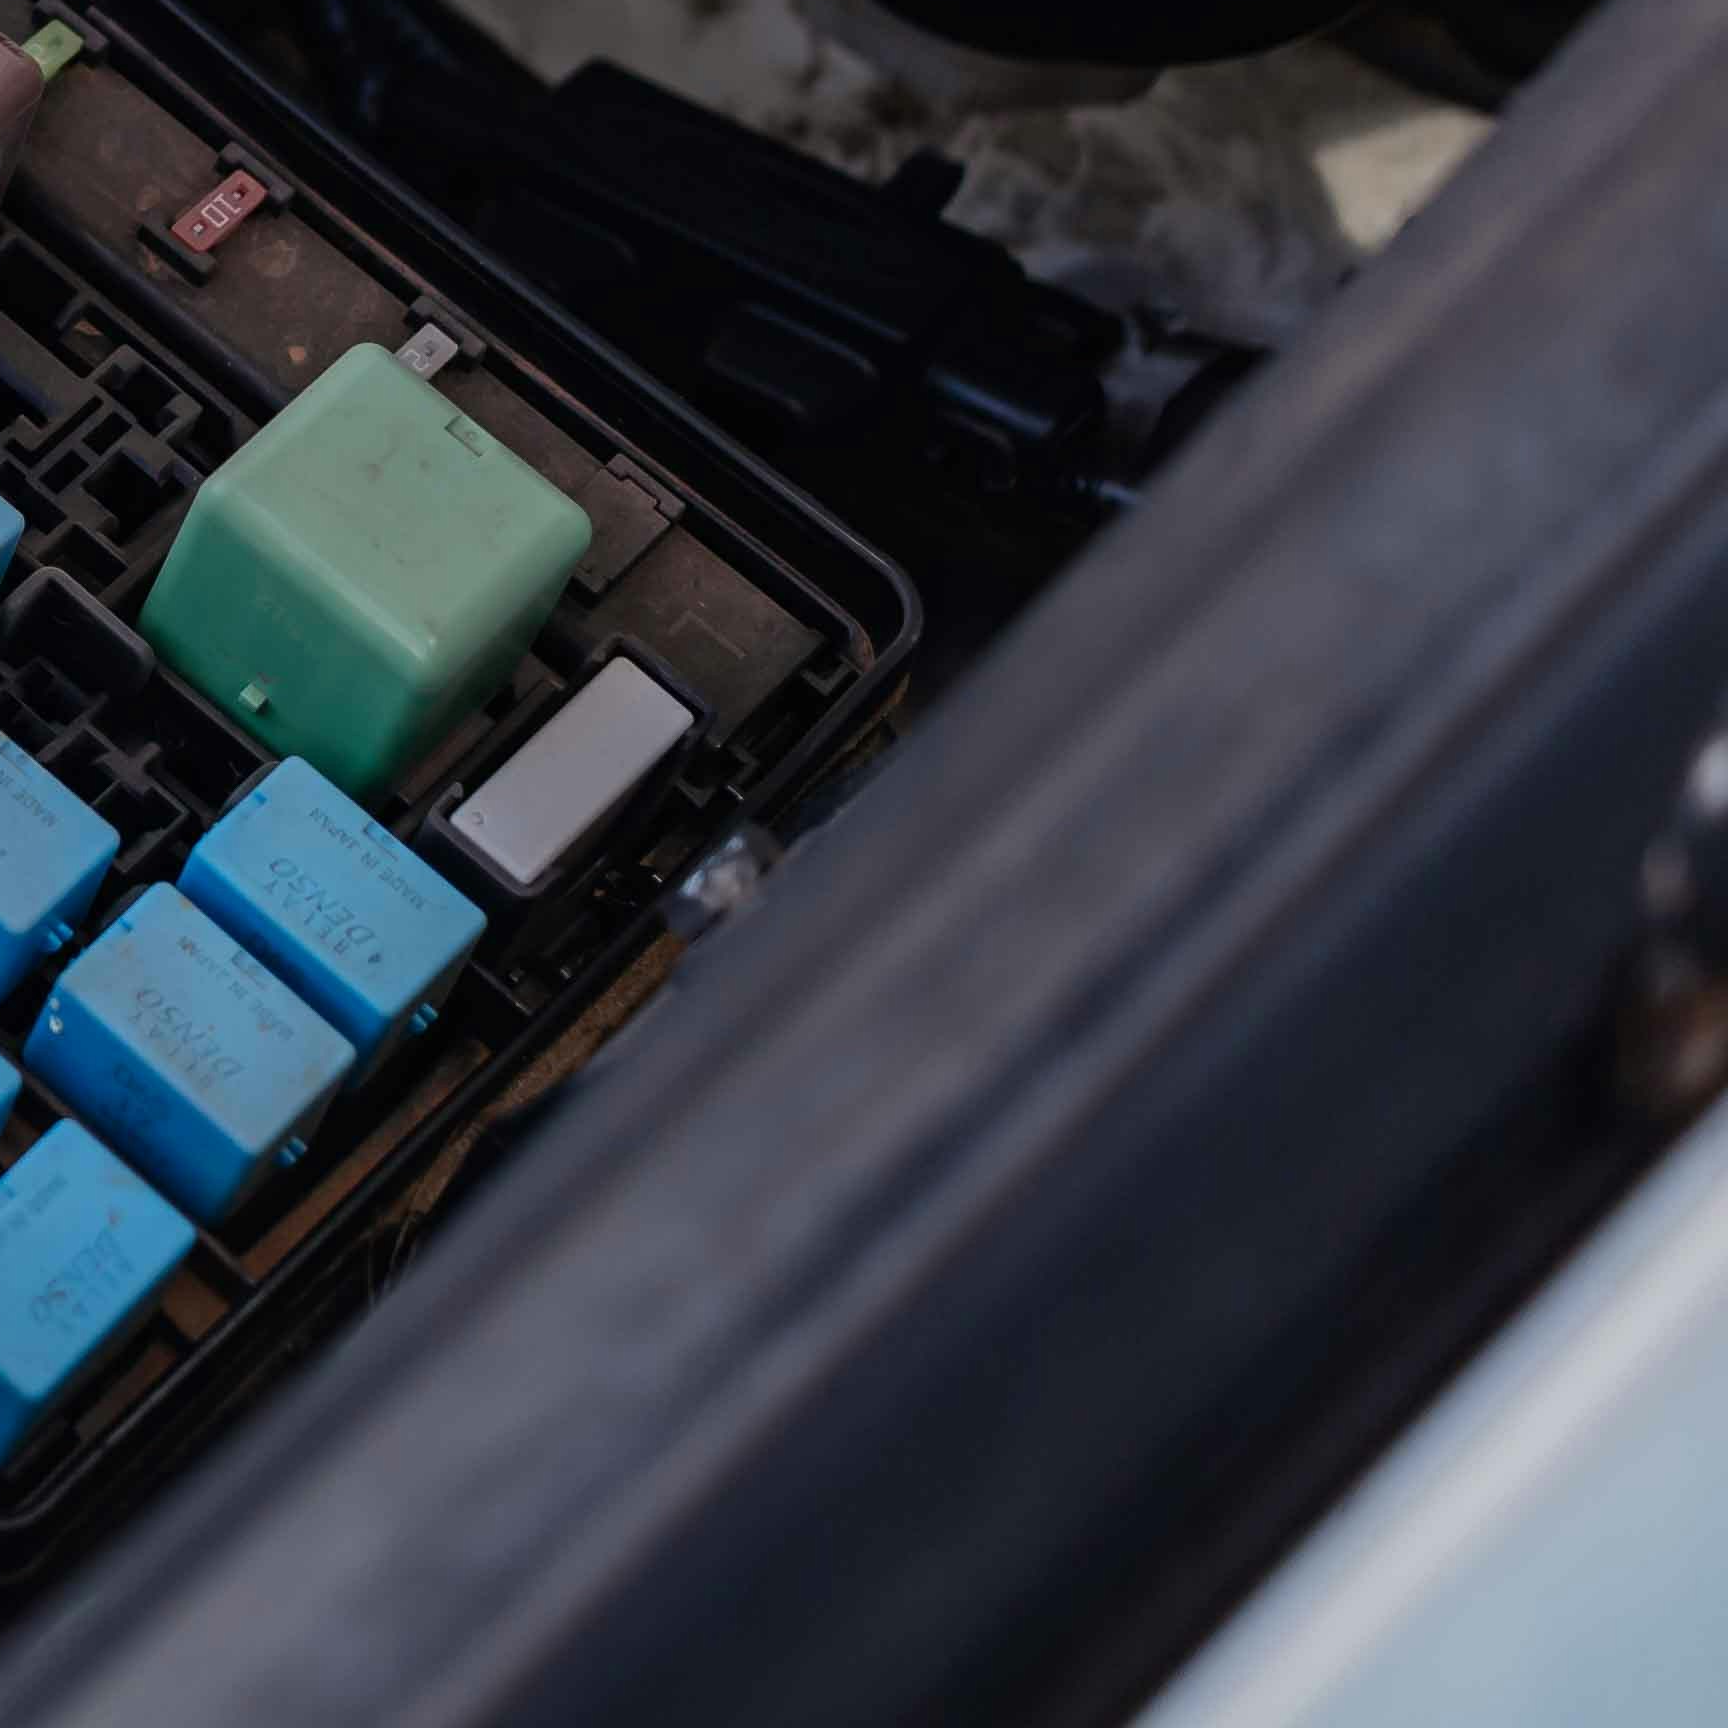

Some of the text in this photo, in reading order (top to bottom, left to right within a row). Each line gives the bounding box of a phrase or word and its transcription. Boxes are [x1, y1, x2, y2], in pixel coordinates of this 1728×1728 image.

[201, 193, 241, 228] 10
[270, 858, 375, 945] DENSO
[135, 989, 246, 1080] DENSO
